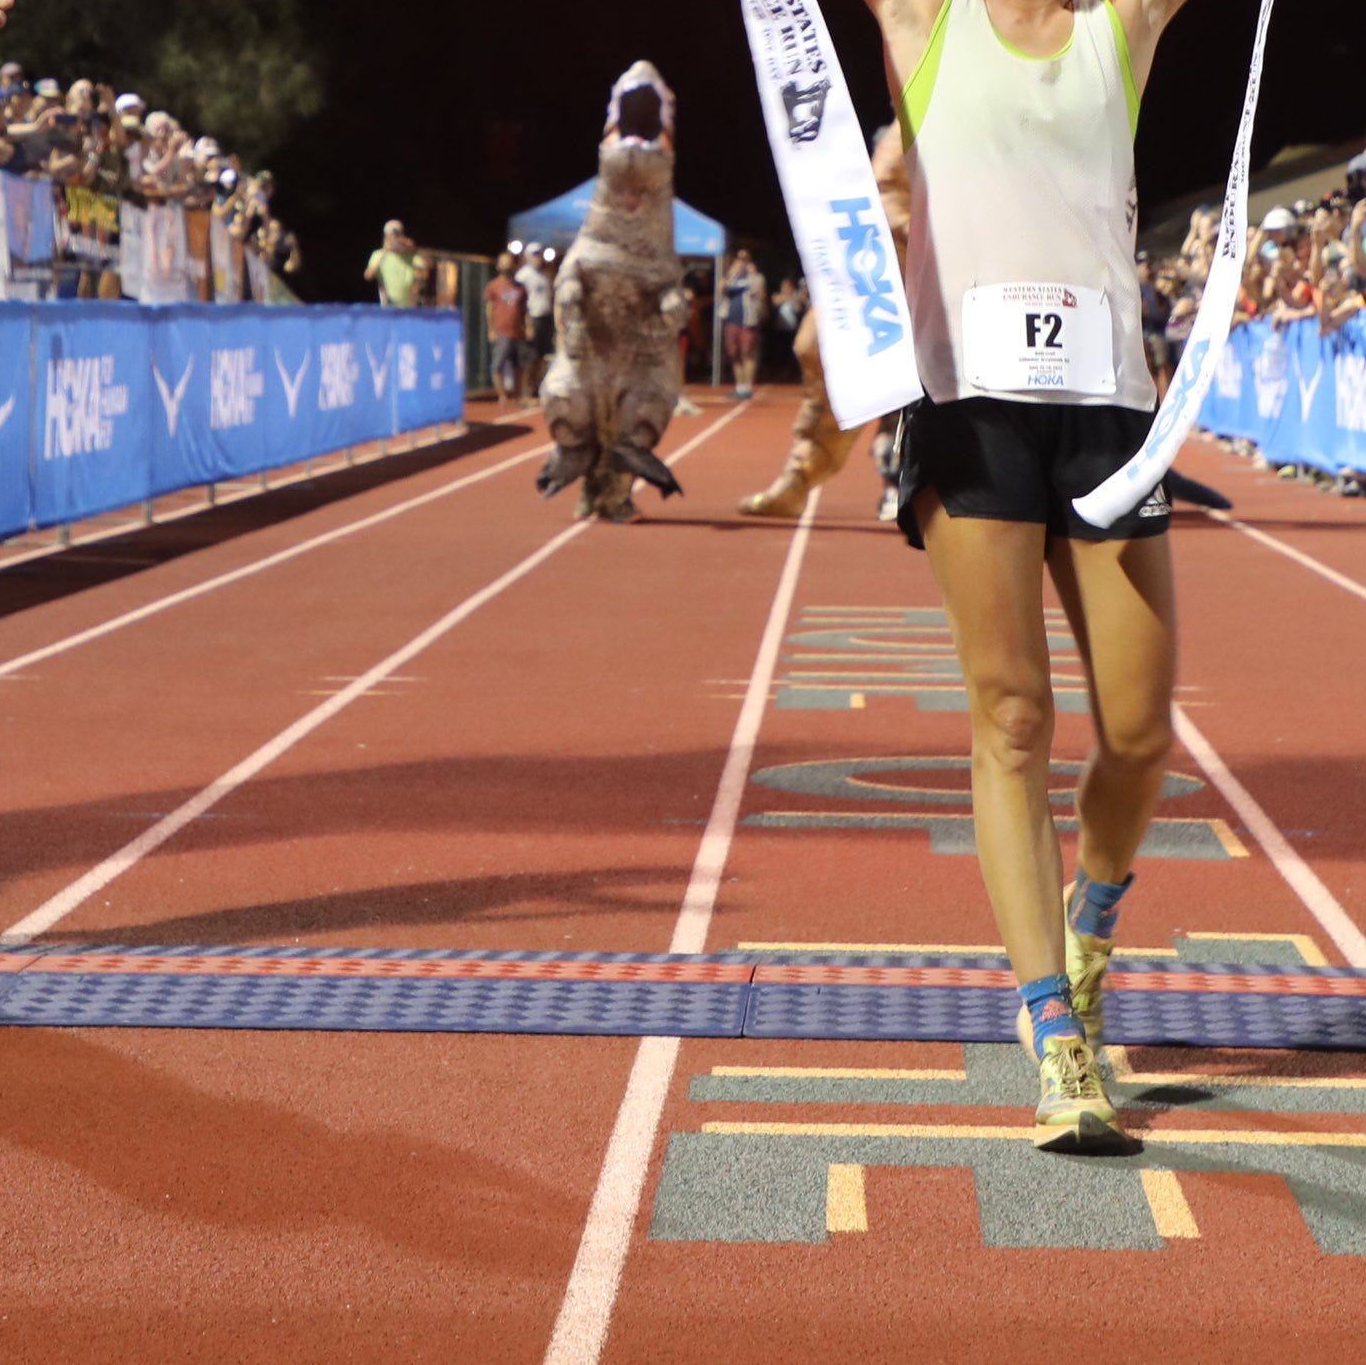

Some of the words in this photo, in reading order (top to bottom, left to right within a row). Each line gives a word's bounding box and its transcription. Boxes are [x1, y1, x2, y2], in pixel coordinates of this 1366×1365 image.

[779, 25, 804, 76] RUN
[829, 197, 904, 357] HOKA
[1025, 313, 1063, 348] F2
[1027, 374, 1065, 386] HOKA
